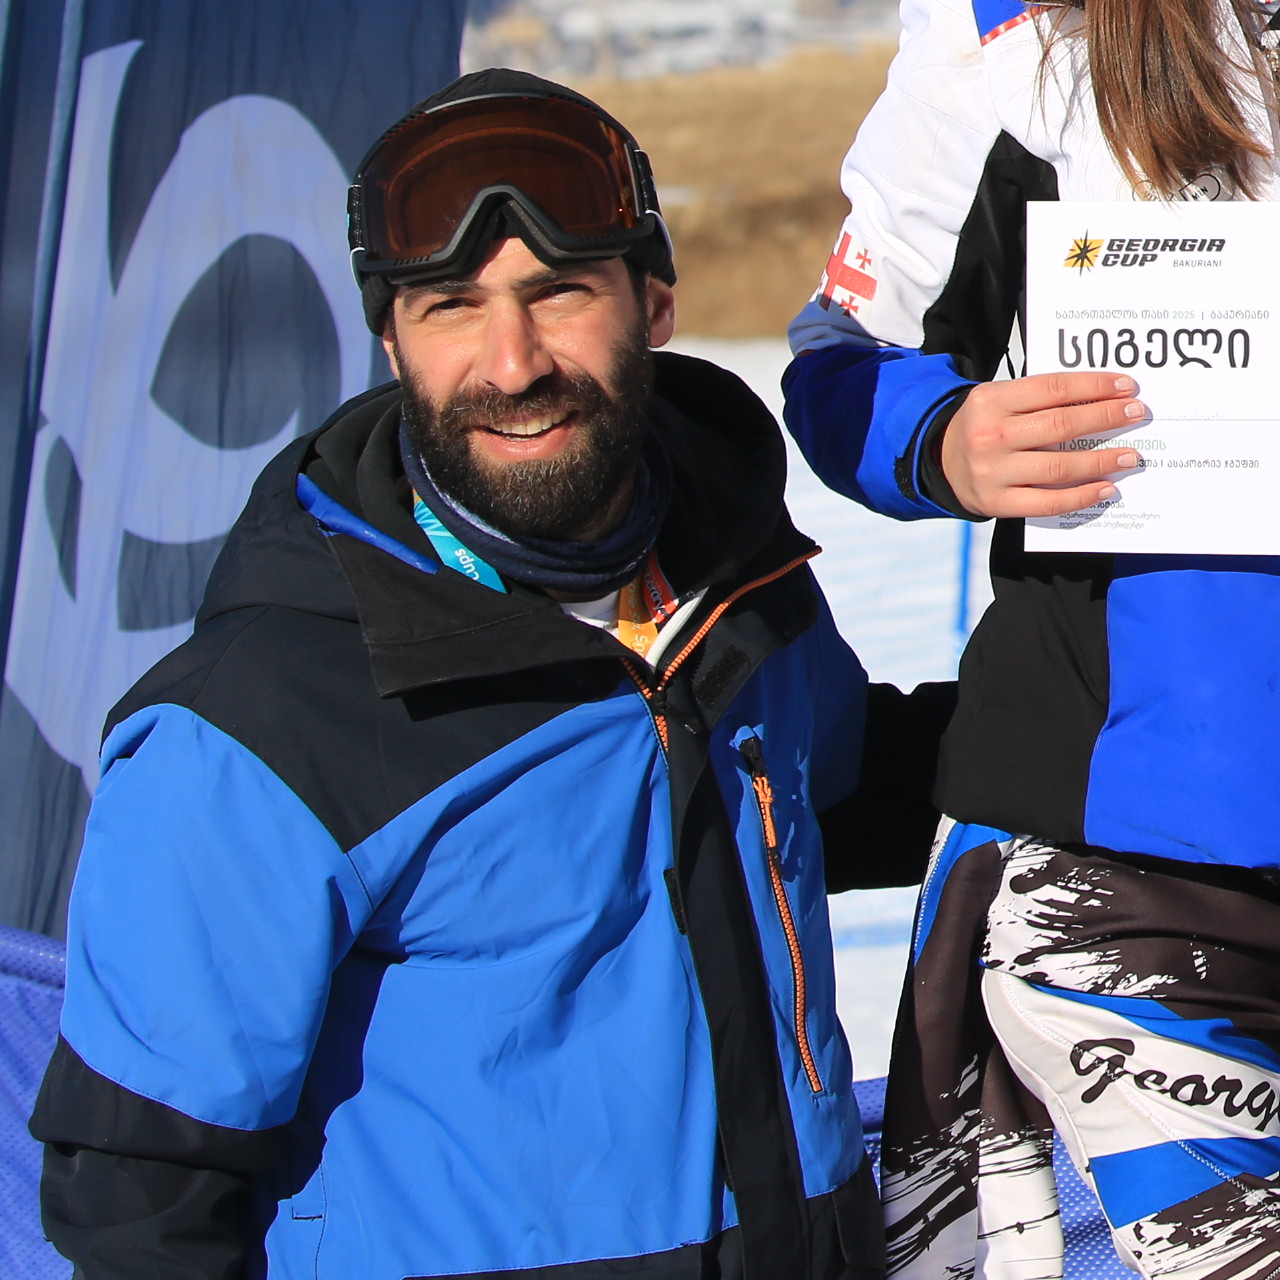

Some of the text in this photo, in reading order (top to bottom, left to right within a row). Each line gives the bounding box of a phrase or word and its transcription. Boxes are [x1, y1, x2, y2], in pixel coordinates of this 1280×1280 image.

[1107, 238, 1226, 252] GEORGIA
[1101, 253, 1222, 267] CUP BAKURIANI
[1172, 310, 1195, 319] 2025
[1058, 328, 1250, 368] სიგელი
[454, 548, 480, 581] cups
